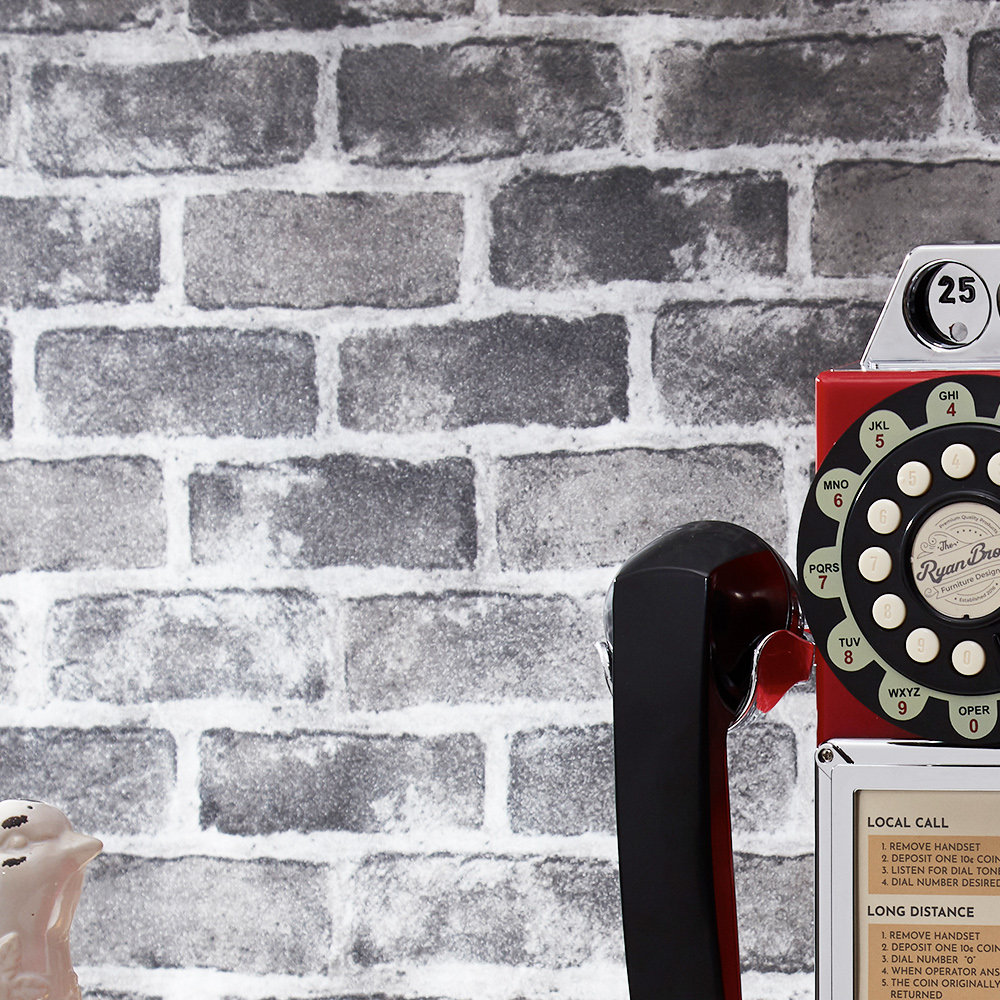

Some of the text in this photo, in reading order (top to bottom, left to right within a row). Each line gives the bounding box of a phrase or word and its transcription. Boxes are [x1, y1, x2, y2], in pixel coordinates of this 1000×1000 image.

[938, 276, 976, 304] 25
[939, 391, 959, 400] GHI
[946, 403, 956, 416] 4
[869, 421, 889, 430] JKL
[875, 434, 884, 448] 5
[952, 453, 960, 469] 4
[909, 471, 916, 486] 5
[824, 480, 849, 490] MNO
[834, 493, 843, 507] 6
[880, 509, 887, 524] 6
[939, 514, 999, 534] Premium Quality Products
[809, 563, 840, 573] PQRS
[870, 556, 878, 571] 7
[818, 575, 827, 589] 7
[941, 568, 1000, 594] Furniture Design
[884, 603, 892, 619] 8
[839, 637, 860, 648] TUV
[917, 638, 925, 653] 9
[844, 650, 853, 665] 8
[888, 688, 921, 698] WXYZ
[898, 701, 907, 715] 9
[959, 705, 990, 716] OPER
[969, 719, 979, 733] 0
[867, 817, 949, 828] LOCAL CALL
[881, 842, 981, 851] 1. REMOVE HANDSET
[881, 855, 888, 863] 2.
[892, 854, 932, 863] DEPOSIT
[935, 855, 957, 863] ONE
[881, 866, 888, 874] 3.
[892, 866, 925, 875] LISTEN
[928, 866, 948, 875] FOR
[951, 867, 973, 875] DIAL
[881, 878, 888, 886] 4.
[892, 878, 914, 886] DIAL
[917, 878, 959, 887] NUMBER
[867, 906, 975, 918] LONG DISTANCE
[881, 931, 980, 940] 1. REMOVE HANDSET
[892, 943, 932, 952] DEPOSIT
[935, 944, 957, 952] ONE
[881, 955, 888, 963] 3.
[892, 955, 914, 963] DIAL
[917, 955, 958, 964] NUMBER
[881, 967, 888, 975] 4.
[891, 967, 922, 975] WHEN
[925, 967, 977, 976] OPERATOR
[881, 979, 888, 987] 5.
[891, 979, 910, 987] THE
[913, 979, 938, 987] COIN
[941, 979, 1000, 988] ORIGINALLY
[890, 990, 943, 999] RETURNED
